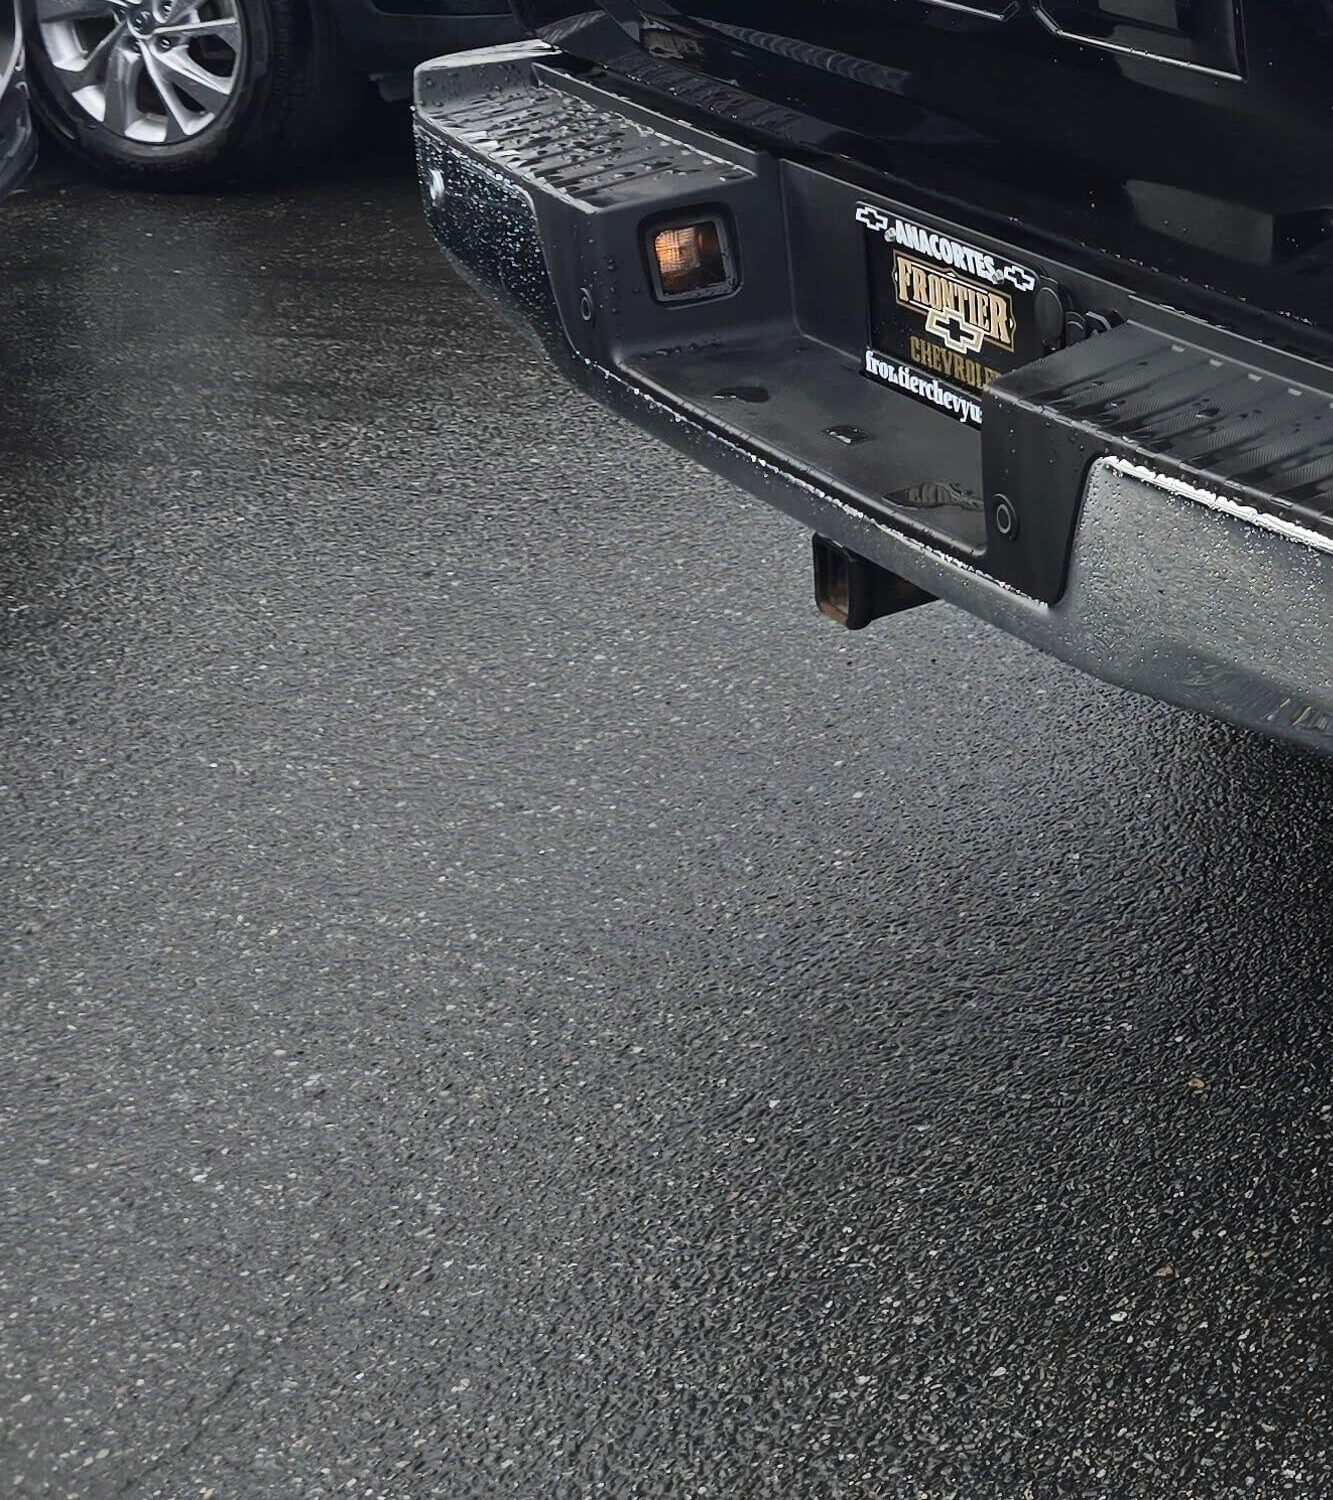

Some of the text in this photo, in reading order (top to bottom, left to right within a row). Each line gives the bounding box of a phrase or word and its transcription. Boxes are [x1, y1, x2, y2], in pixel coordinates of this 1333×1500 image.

[895, 219, 998, 285] ANACORTES
[897, 256, 1011, 345] FRONTIER
[865, 350, 983, 424] frontierchevyu
[910, 335, 1001, 389] CHEVROLE
